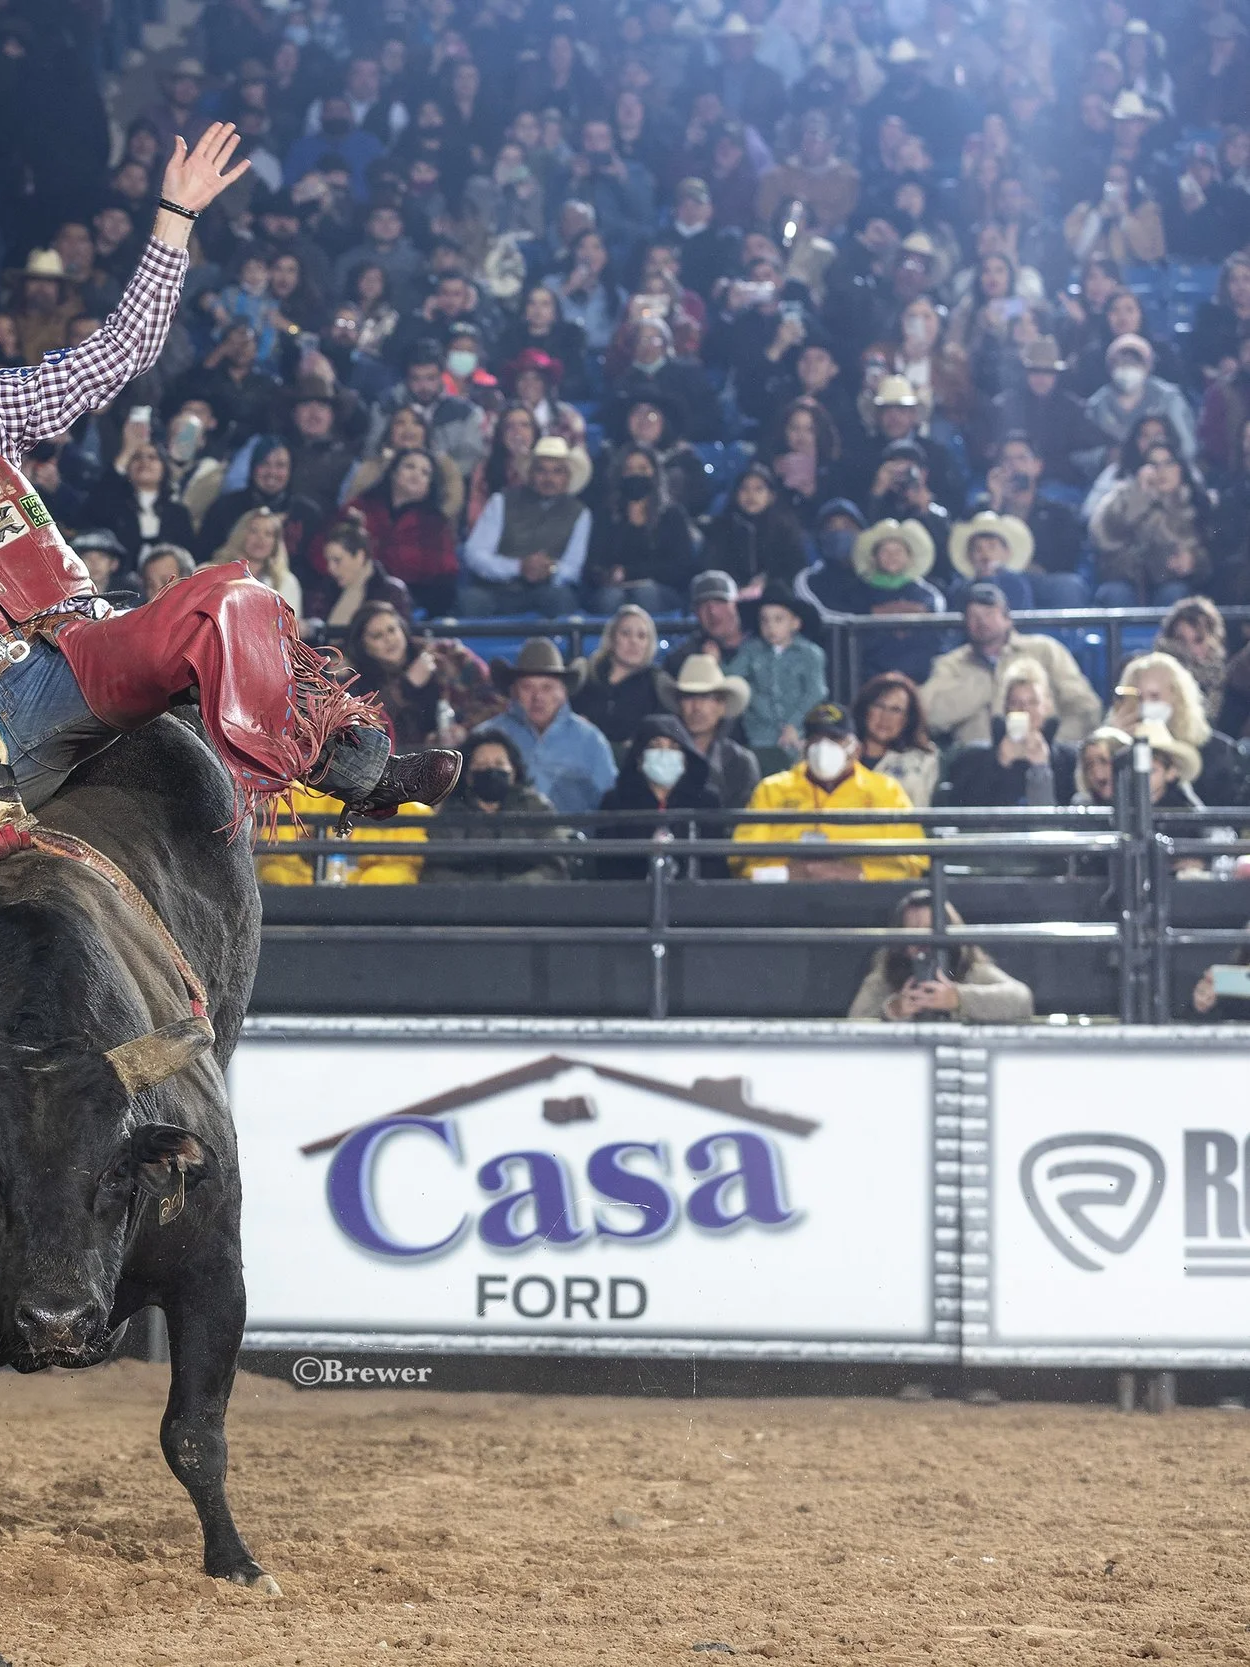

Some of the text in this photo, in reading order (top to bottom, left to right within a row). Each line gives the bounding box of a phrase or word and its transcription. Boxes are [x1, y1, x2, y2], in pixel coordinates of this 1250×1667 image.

[327, 1116, 806, 1258] Casa
[1184, 1129, 1250, 1239] R
[477, 1275, 649, 1322] FORD
